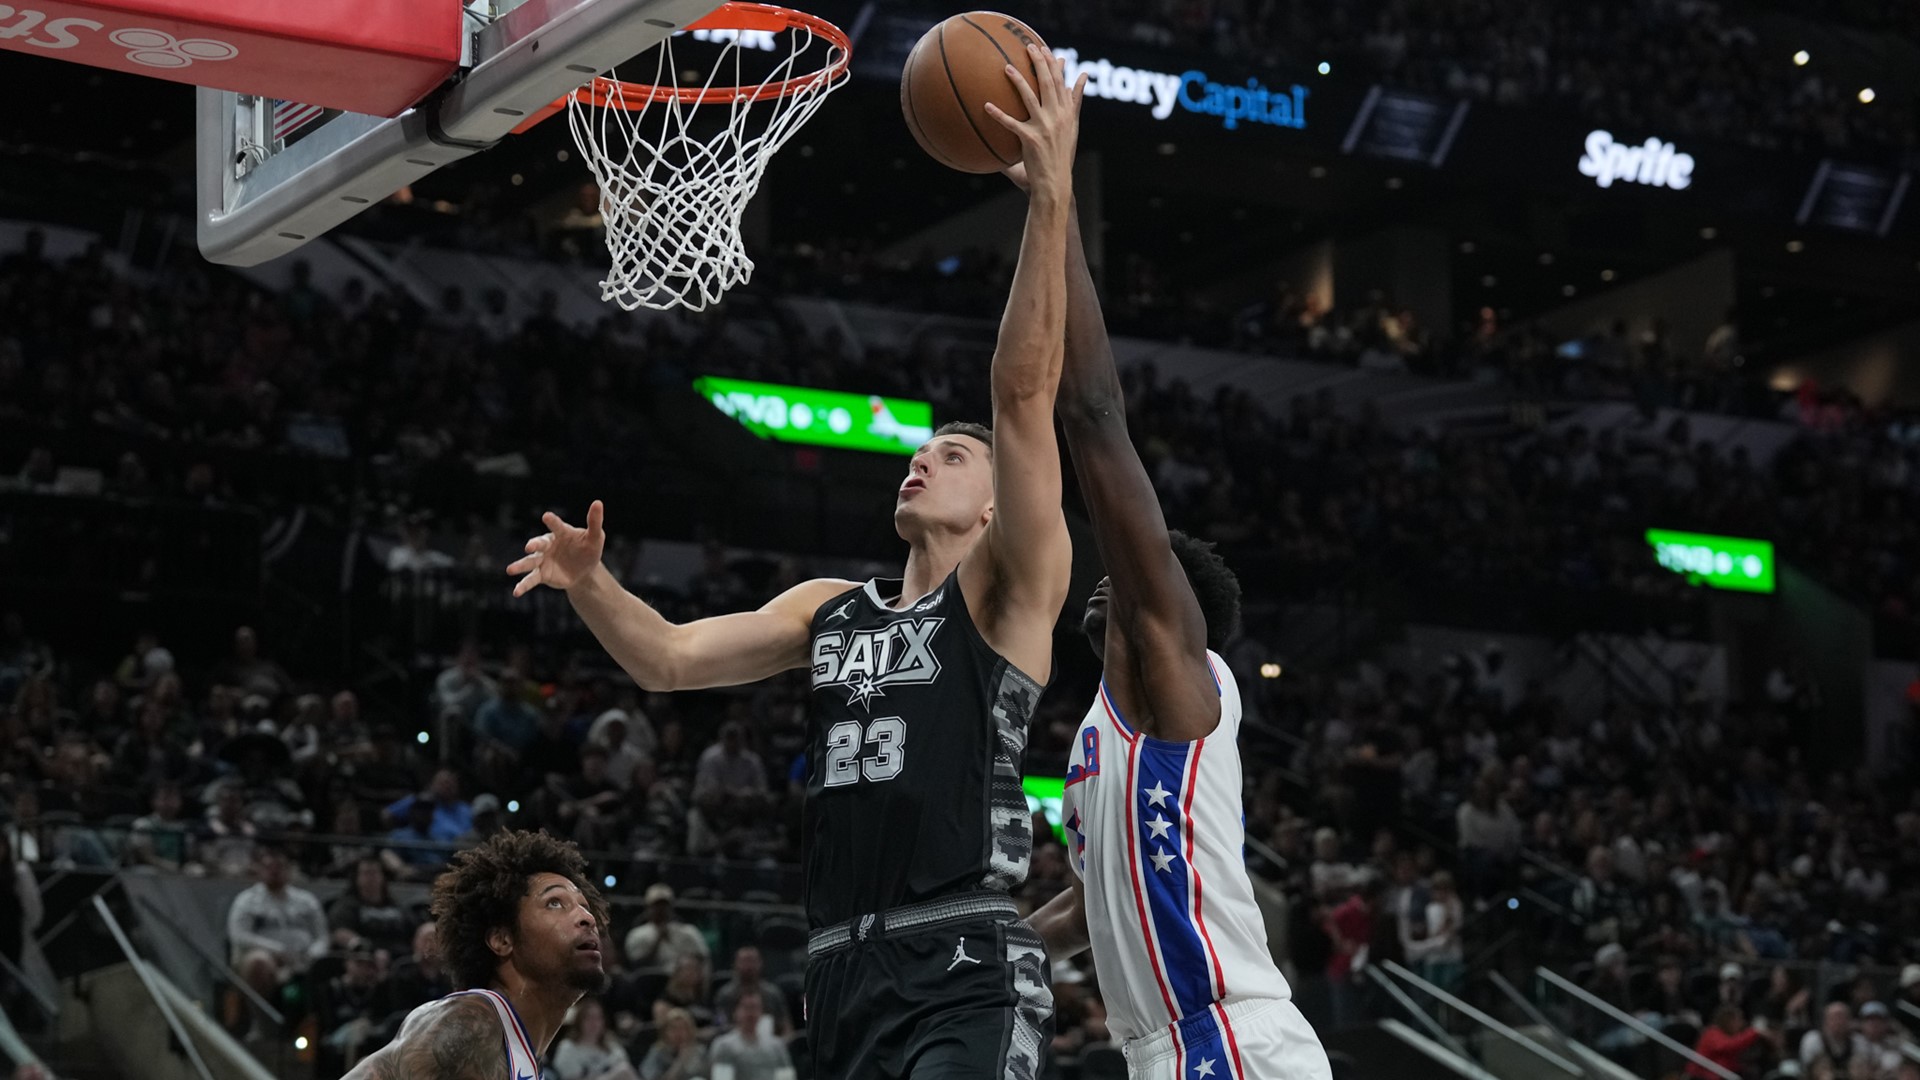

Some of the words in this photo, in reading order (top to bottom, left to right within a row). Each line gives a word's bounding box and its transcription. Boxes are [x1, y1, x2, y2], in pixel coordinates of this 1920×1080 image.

[1578, 130, 1695, 190] Sprite
[811, 617, 946, 691] SATX
[824, 716, 906, 787] 23
